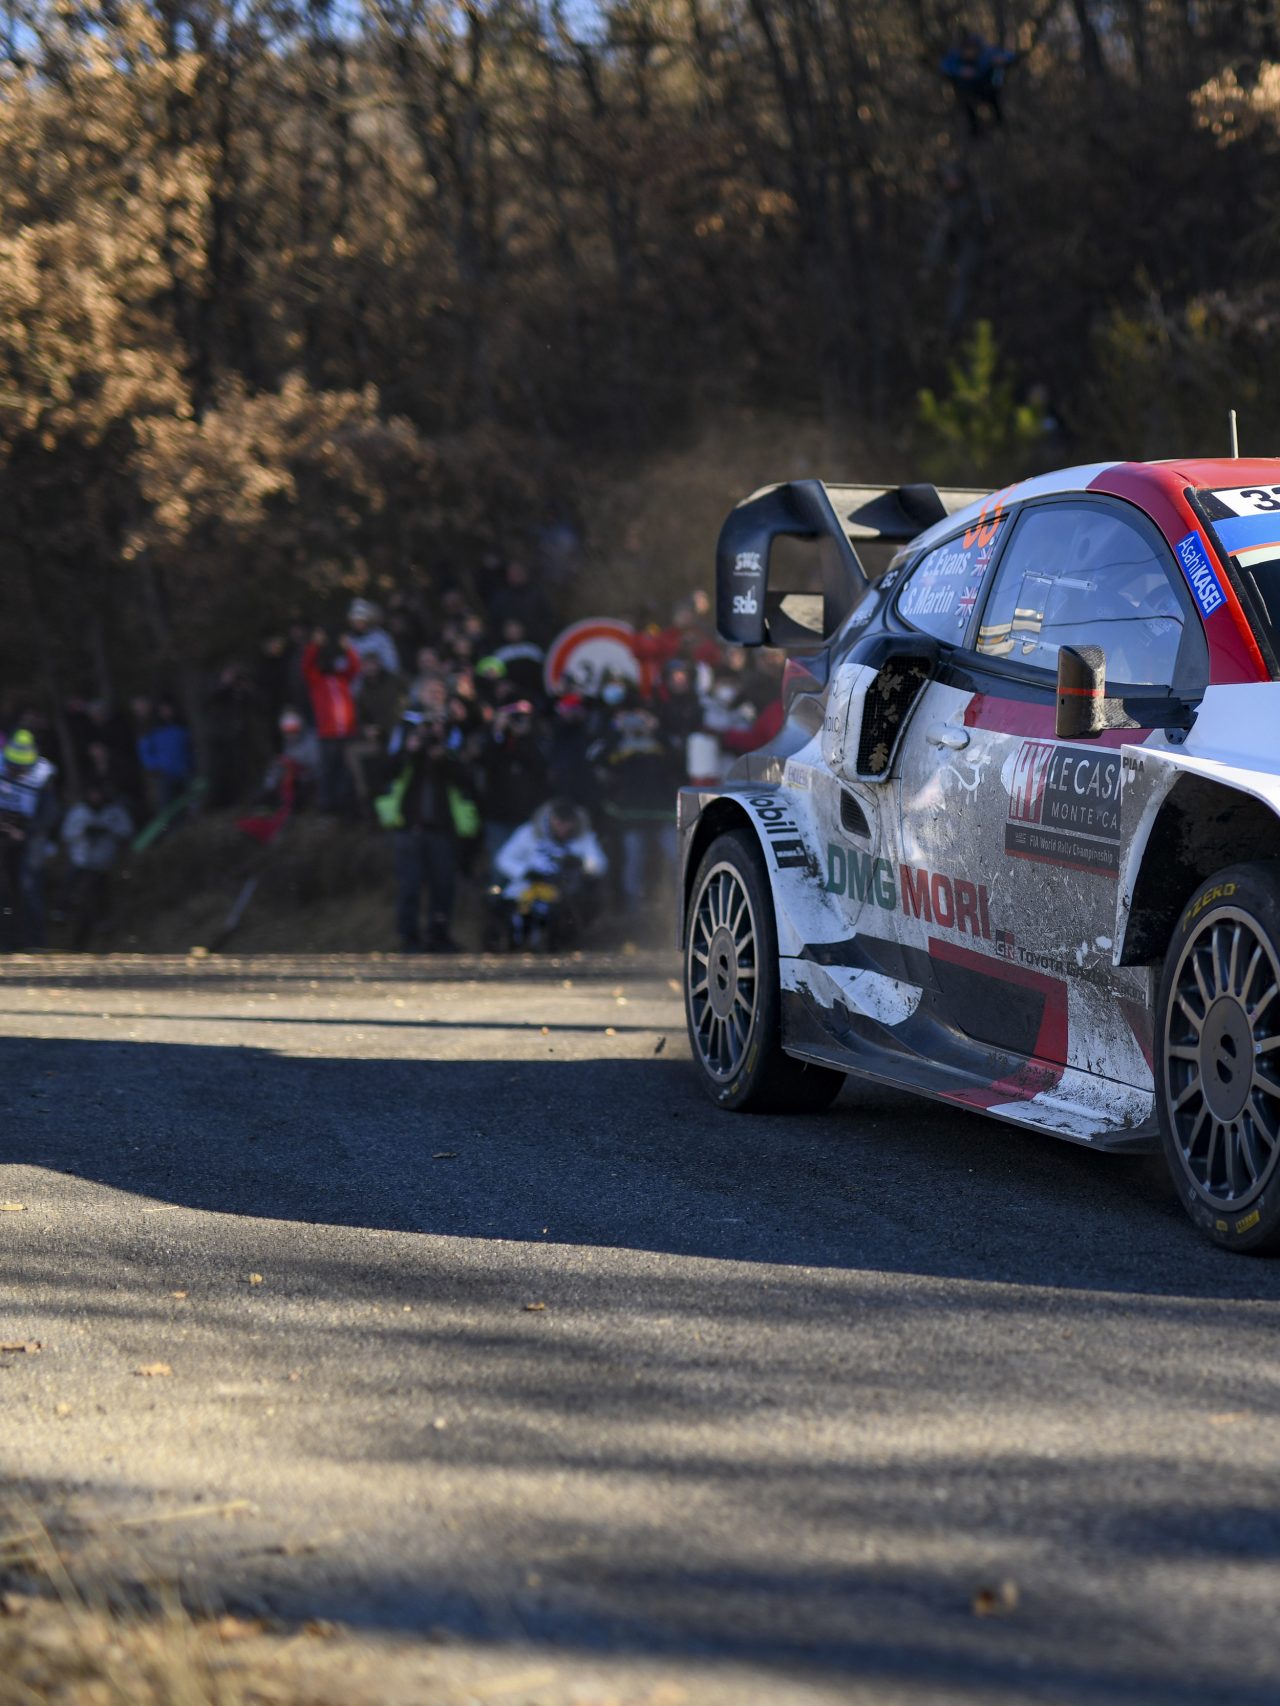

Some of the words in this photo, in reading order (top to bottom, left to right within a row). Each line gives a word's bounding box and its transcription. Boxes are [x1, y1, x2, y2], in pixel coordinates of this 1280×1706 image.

[1178, 535, 1222, 614] AsahiKASEI
[1122, 756, 1145, 773] PIAA
[825, 843, 897, 911] DMG
[900, 863, 992, 940] MORI
[1018, 947, 1063, 974] TOYOTA
